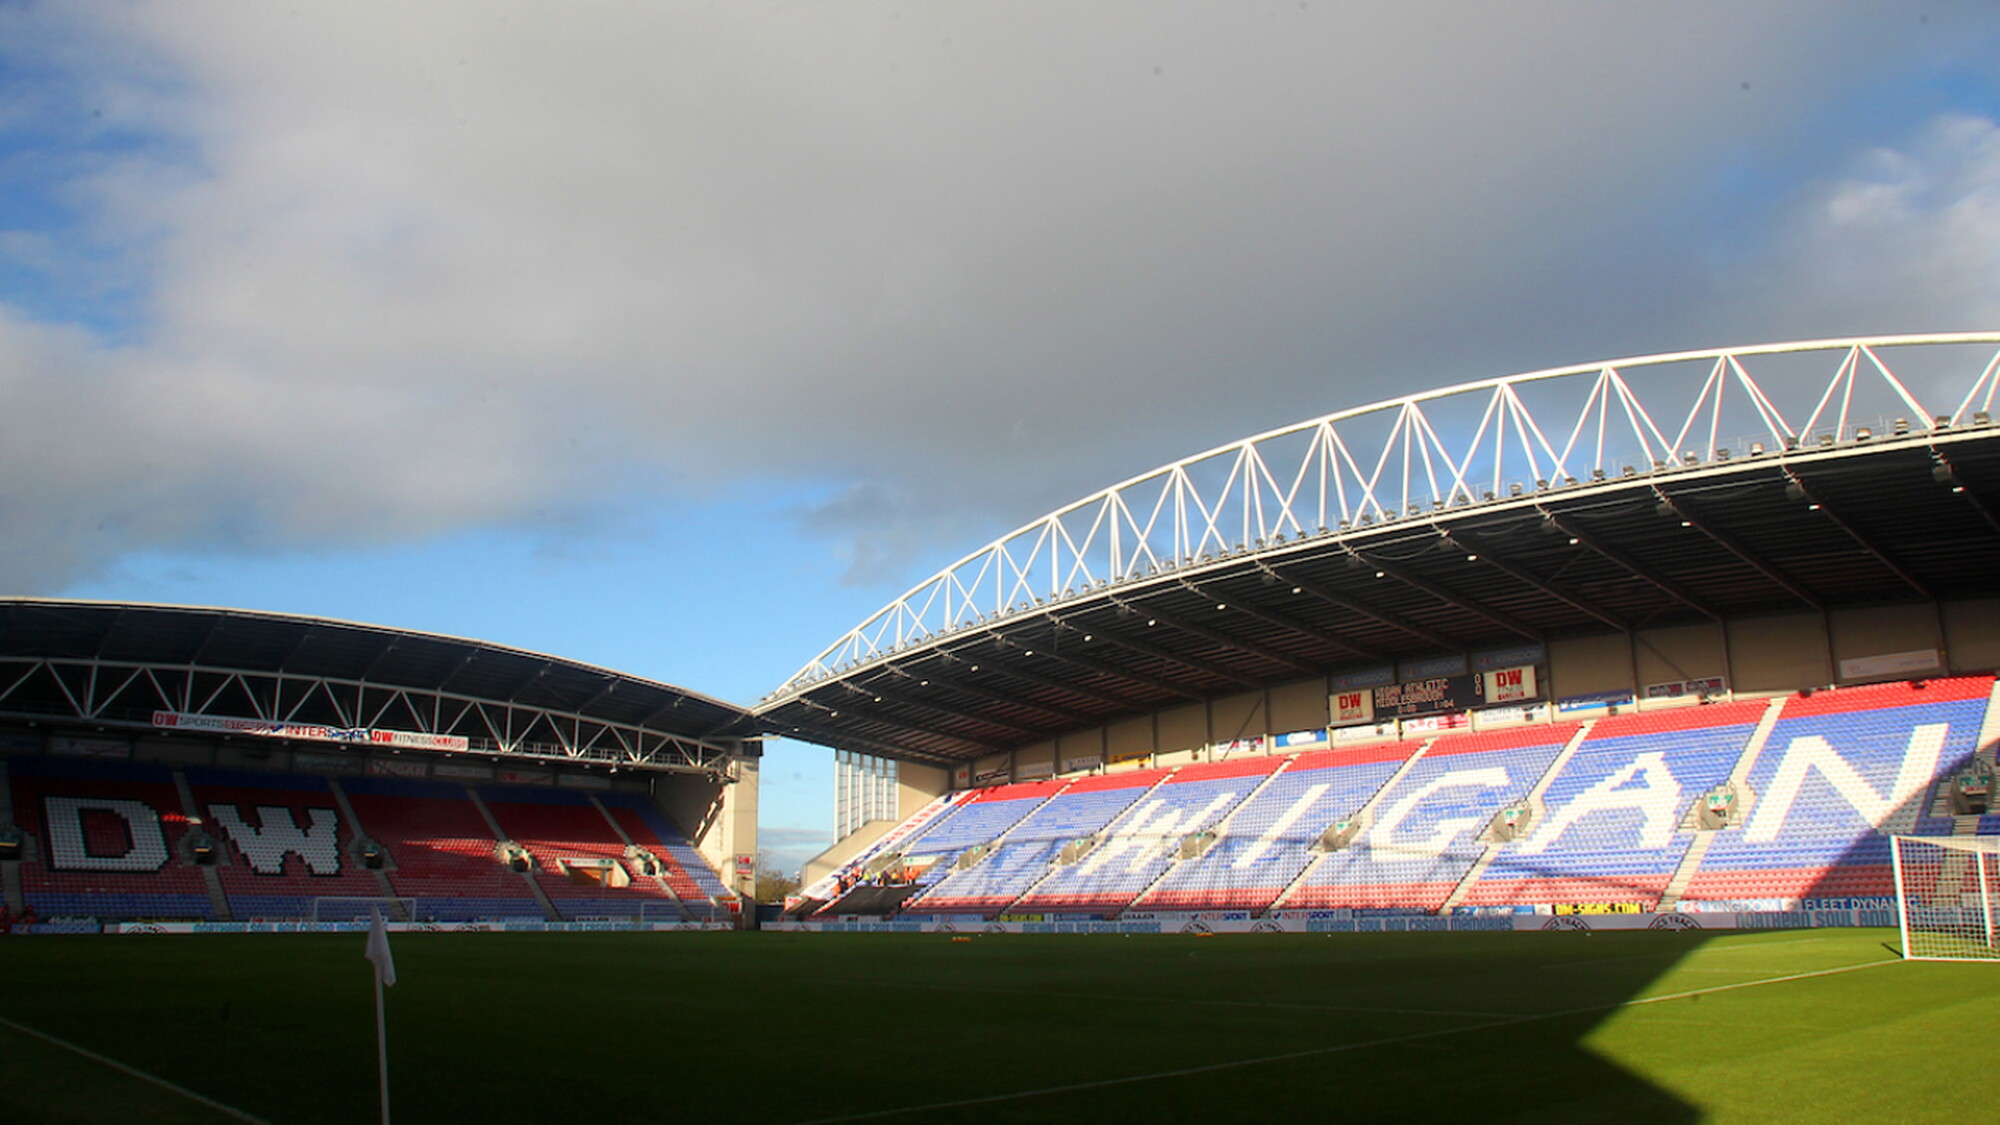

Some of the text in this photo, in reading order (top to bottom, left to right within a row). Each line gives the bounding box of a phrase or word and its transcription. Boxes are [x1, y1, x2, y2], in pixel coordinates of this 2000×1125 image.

[1496, 669, 1522, 687] DW
[1339, 694, 1361, 709] DW
[1079, 723, 1949, 876] WIGAN
[44, 797, 341, 876] DW
[1556, 903, 1641, 915] DM-SIGNS.COM
[1708, 900, 1777, 912] KINGDOM
[1804, 899, 1846, 911] FLEET
[1200, 912, 1247, 920] INTERSPORT
[1282, 911, 1335, 919] INTERSPORT
[1815, 911, 1854, 928] SOUL
[1859, 910, 1890, 927] AND
